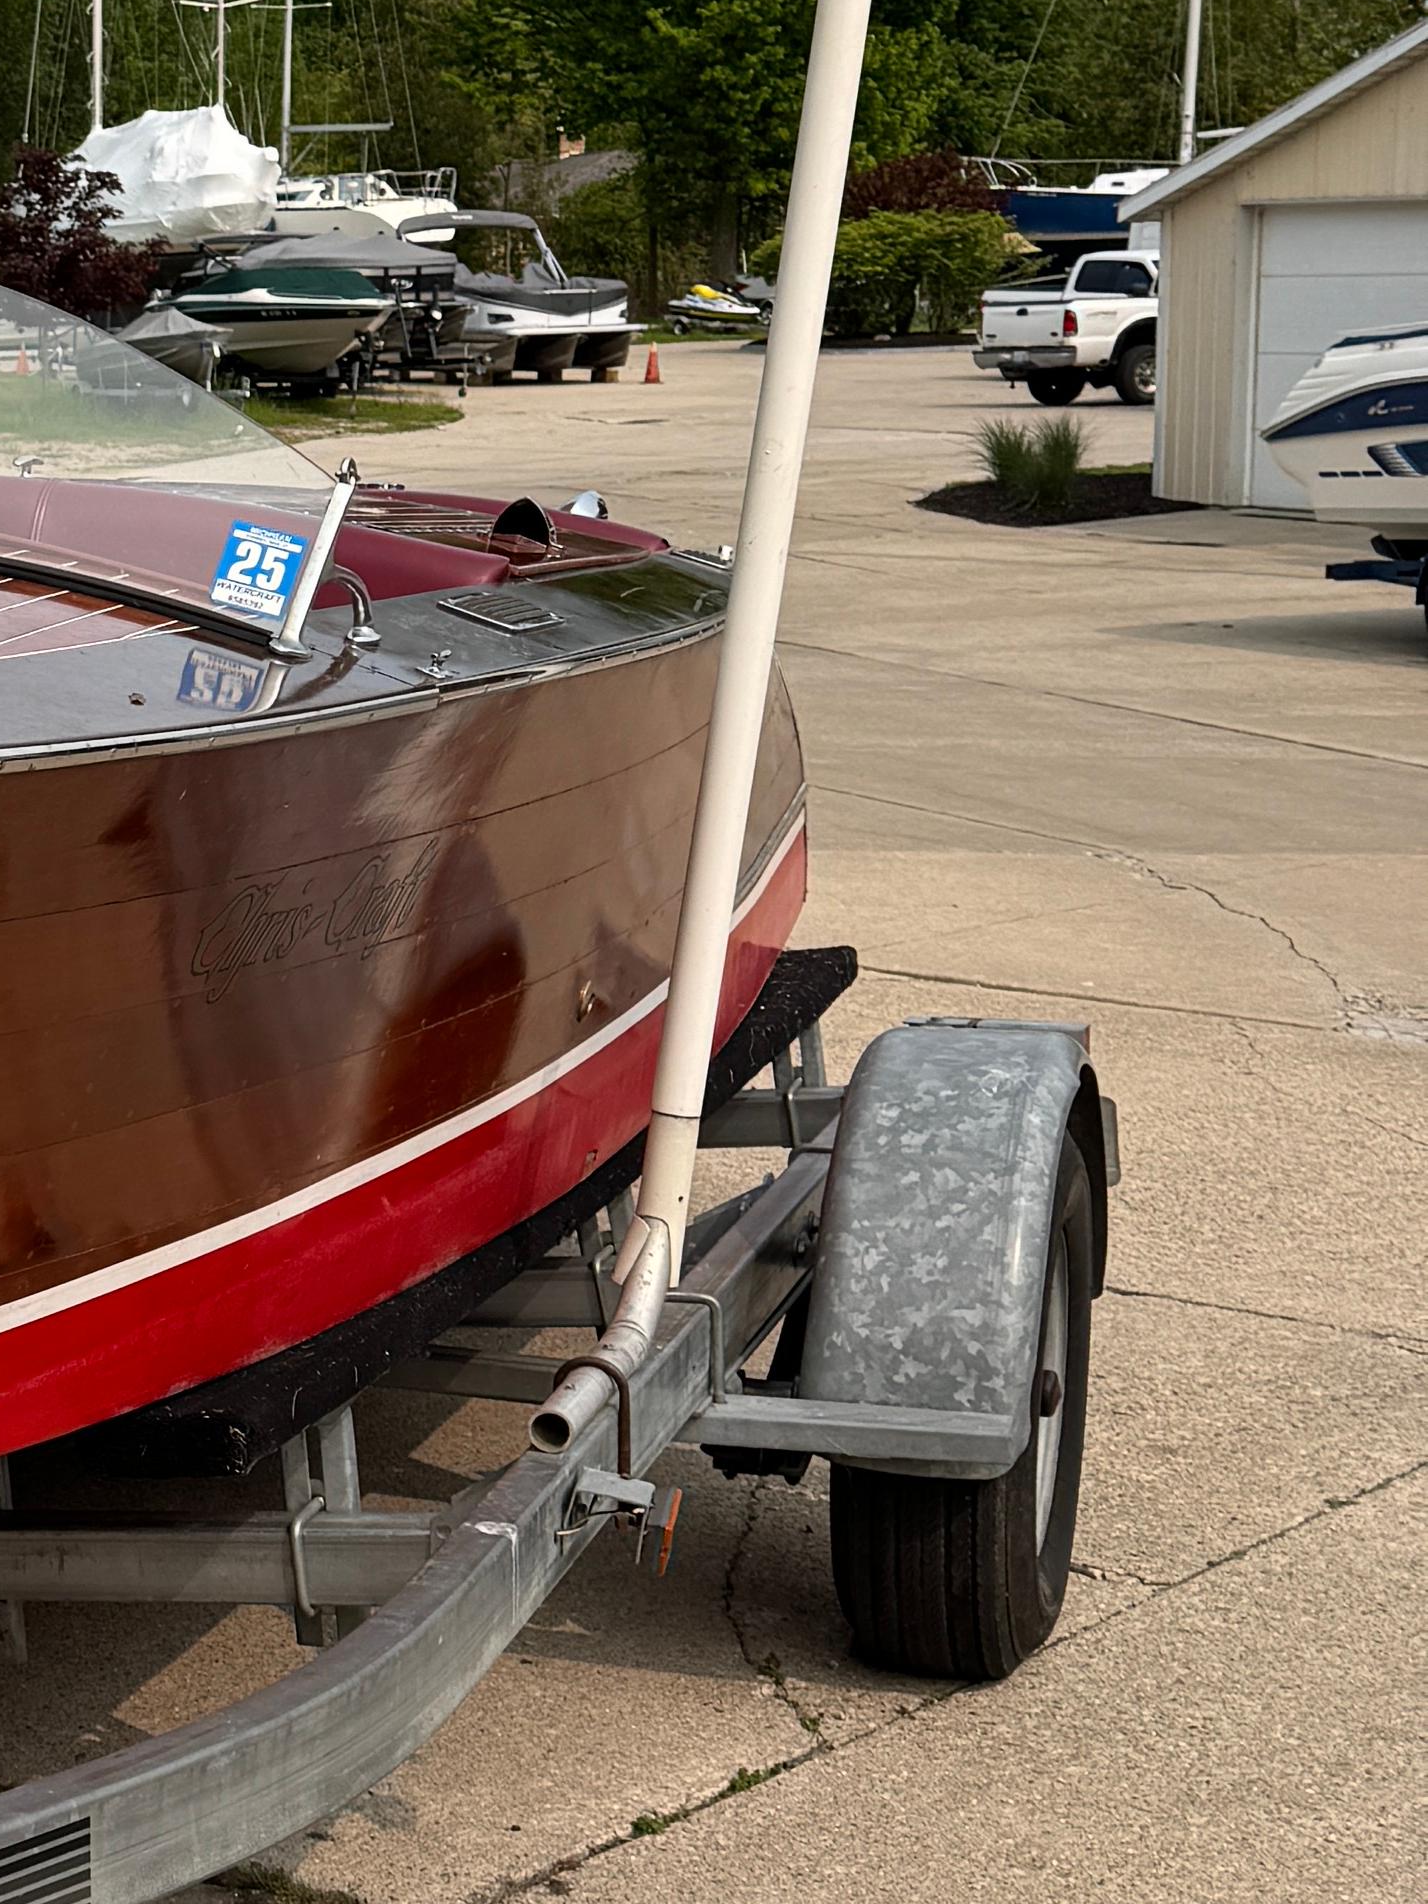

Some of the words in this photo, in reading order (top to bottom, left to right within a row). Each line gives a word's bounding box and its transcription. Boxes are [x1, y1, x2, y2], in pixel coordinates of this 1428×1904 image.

[217, 581, 282, 603] WATERCRAFT
[226, 540, 289, 592] 25
[190, 836, 440, 1005] Chris-Craft
